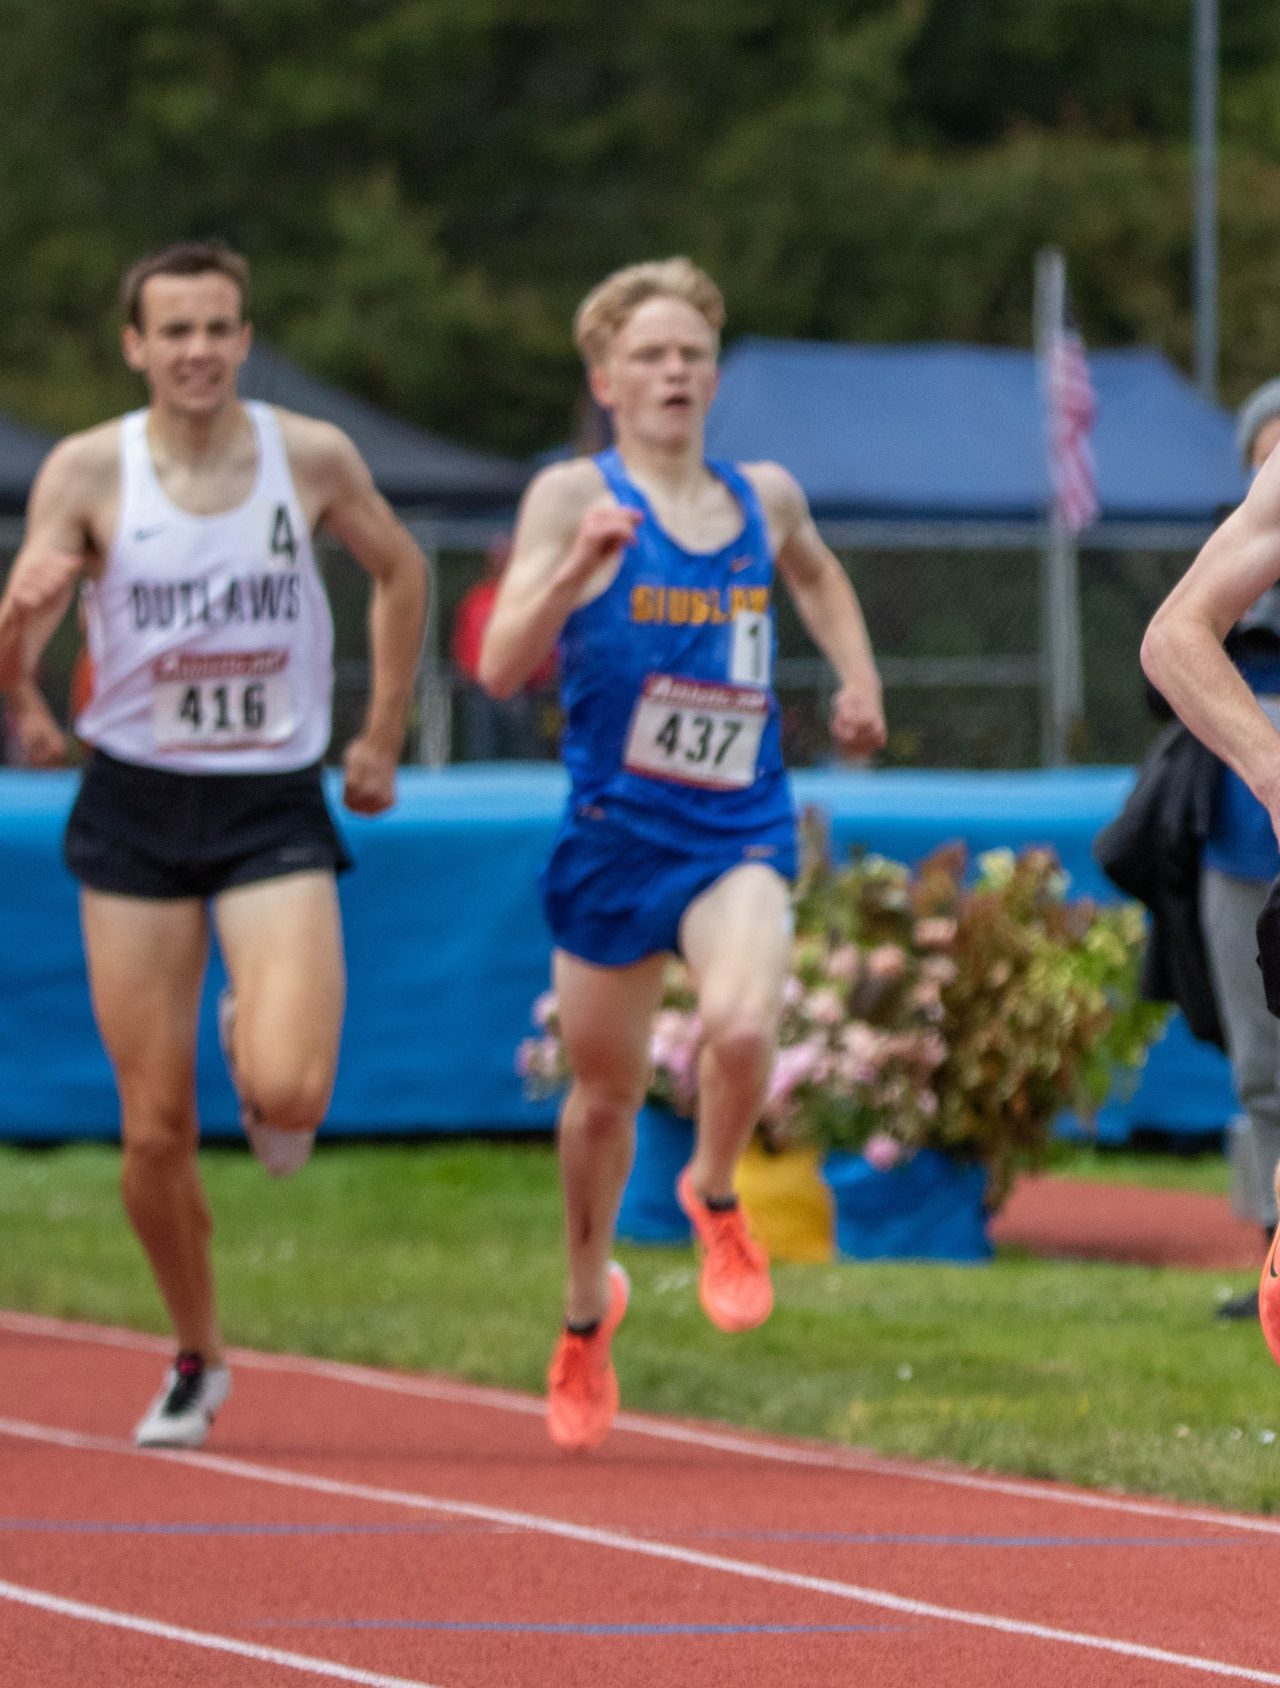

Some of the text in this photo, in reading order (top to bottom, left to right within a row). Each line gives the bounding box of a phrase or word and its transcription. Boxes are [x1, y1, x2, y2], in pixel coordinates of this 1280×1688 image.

[271, 503, 296, 560] 4
[132, 573, 299, 631] OUTLAWS
[179, 682, 267, 733] 416
[655, 711, 743, 767] 437
